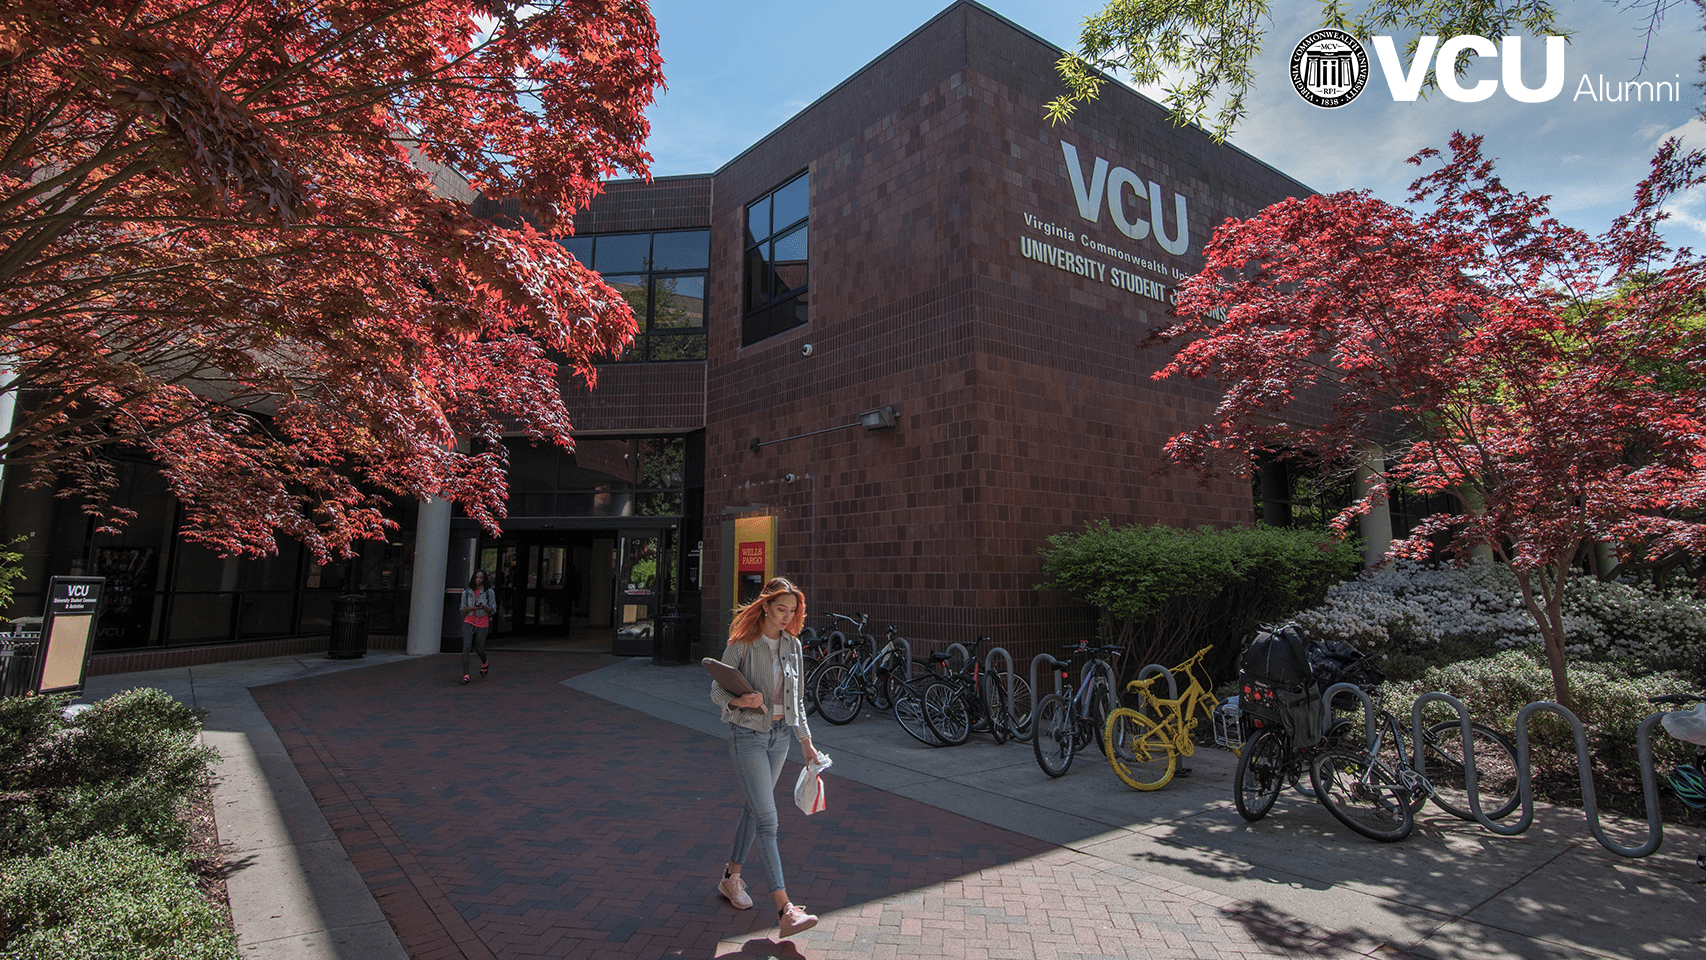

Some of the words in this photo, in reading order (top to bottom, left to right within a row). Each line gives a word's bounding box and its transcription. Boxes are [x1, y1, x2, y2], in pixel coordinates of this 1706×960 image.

[1060, 139, 1190, 256] VCU
[1023, 211, 1075, 242] Virginia
[1080, 233, 1168, 276] Commonwealth
[1020, 235, 1106, 282] UNIVERSITY
[1110, 267, 1166, 302] STUDENT
[741, 548, 763, 556] WELLS
[742, 556, 763, 565] FARGO
[67, 585, 90, 597] VCU
